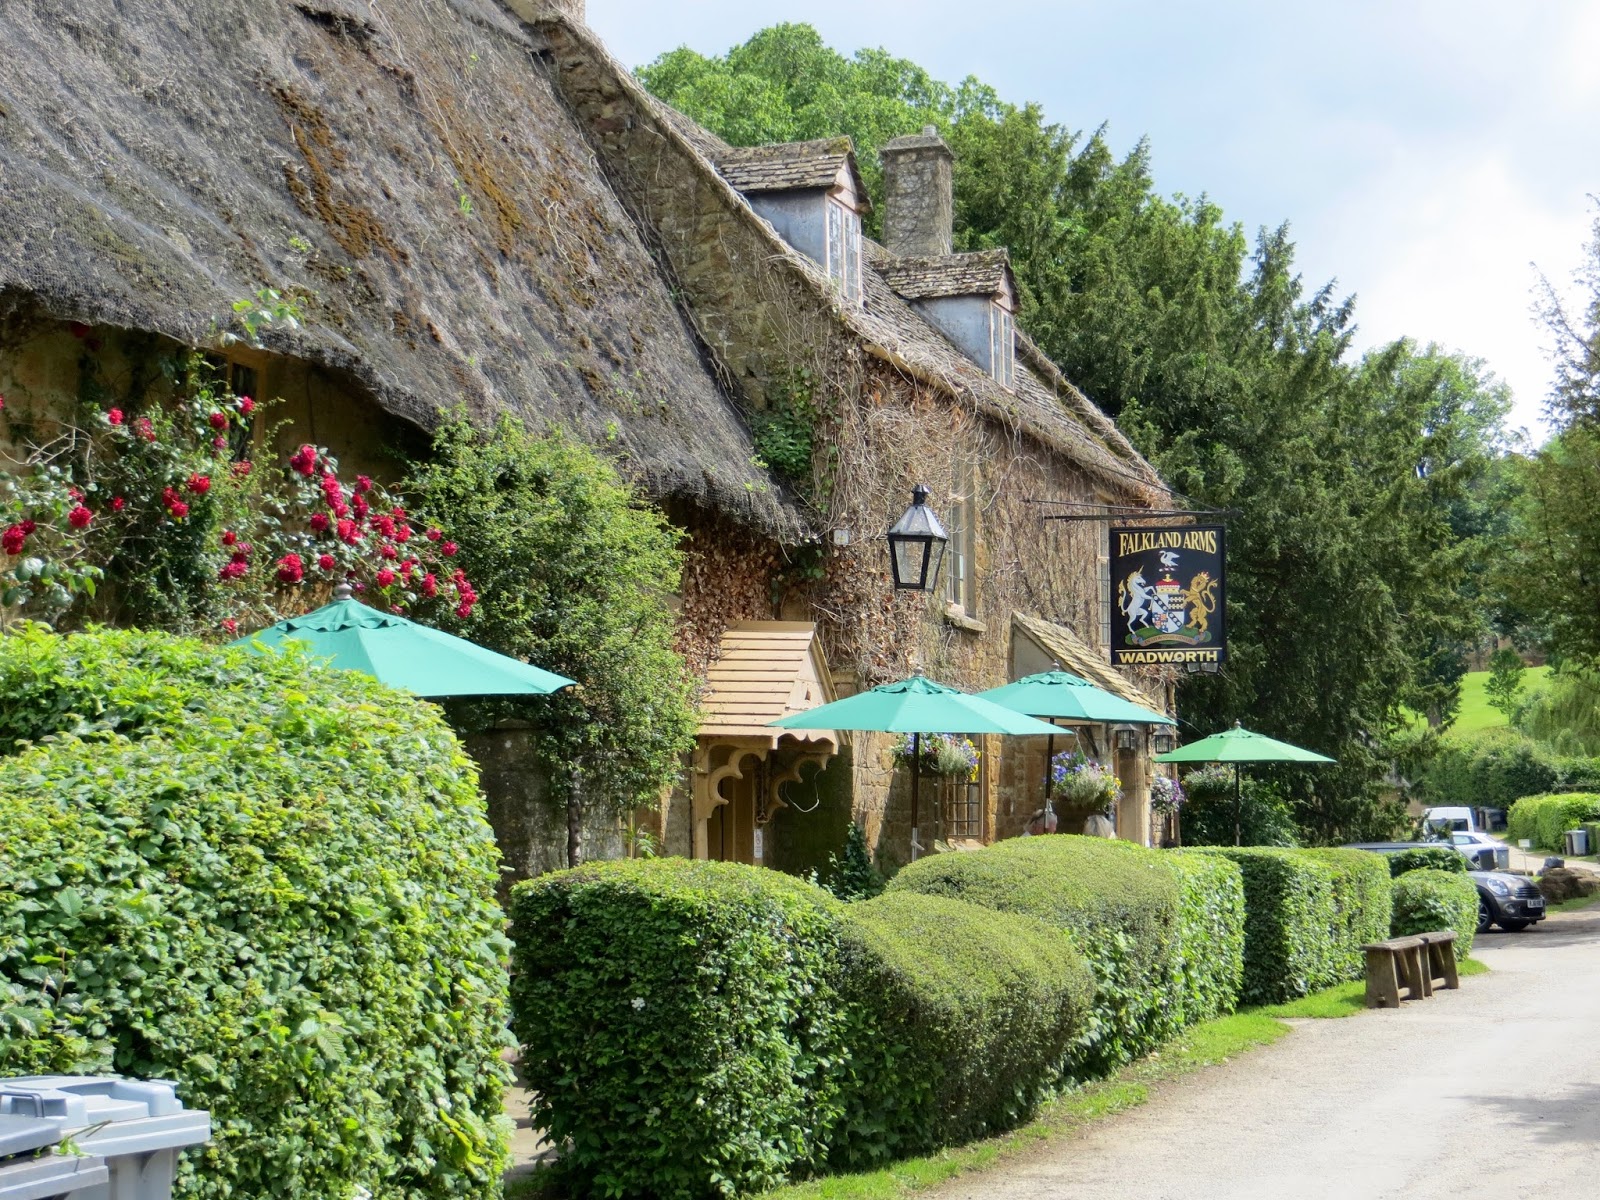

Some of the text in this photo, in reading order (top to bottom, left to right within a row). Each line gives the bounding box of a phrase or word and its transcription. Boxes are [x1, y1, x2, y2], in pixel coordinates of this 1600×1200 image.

[1119, 531, 1217, 557] FALKLAND ARMS
[1119, 651, 1218, 663] WADWORTH
